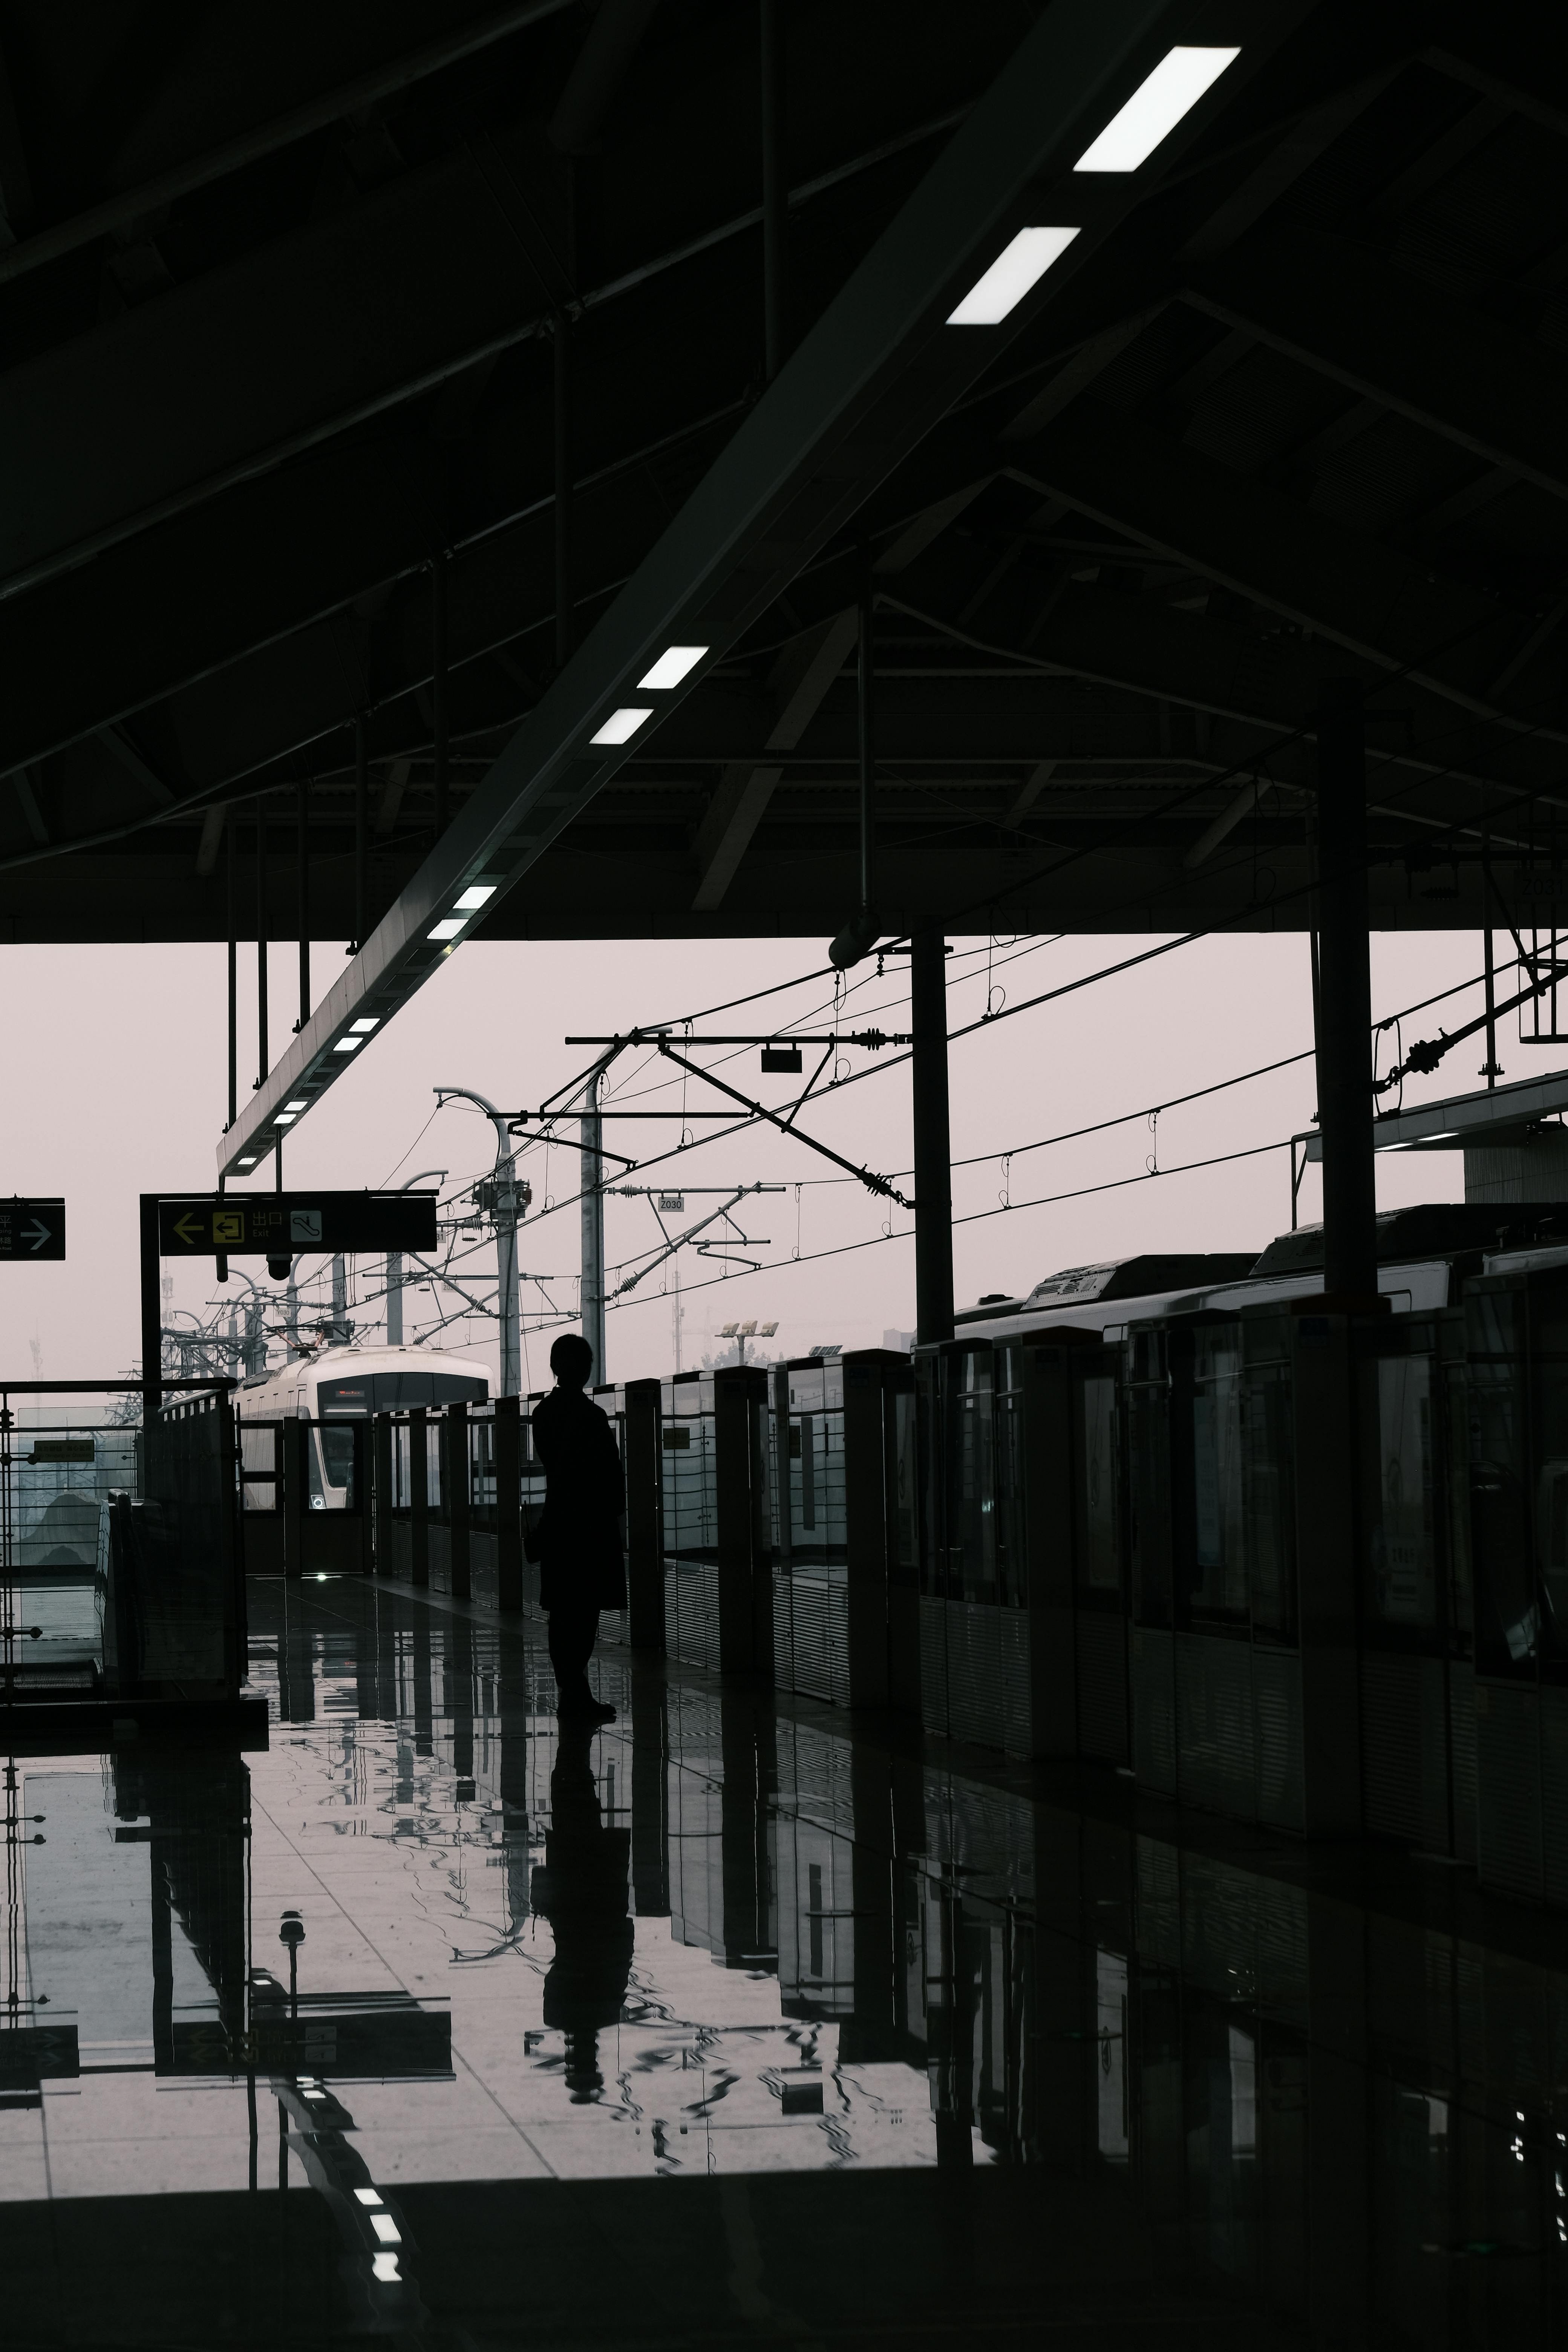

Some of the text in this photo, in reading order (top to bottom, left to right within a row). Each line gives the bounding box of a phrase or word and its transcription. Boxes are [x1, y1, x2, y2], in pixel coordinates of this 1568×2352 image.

[1522, 878, 1563, 896] Z031
[253, 1211, 282, 1226] 出口
[253, 1229, 269, 1237] Exit
